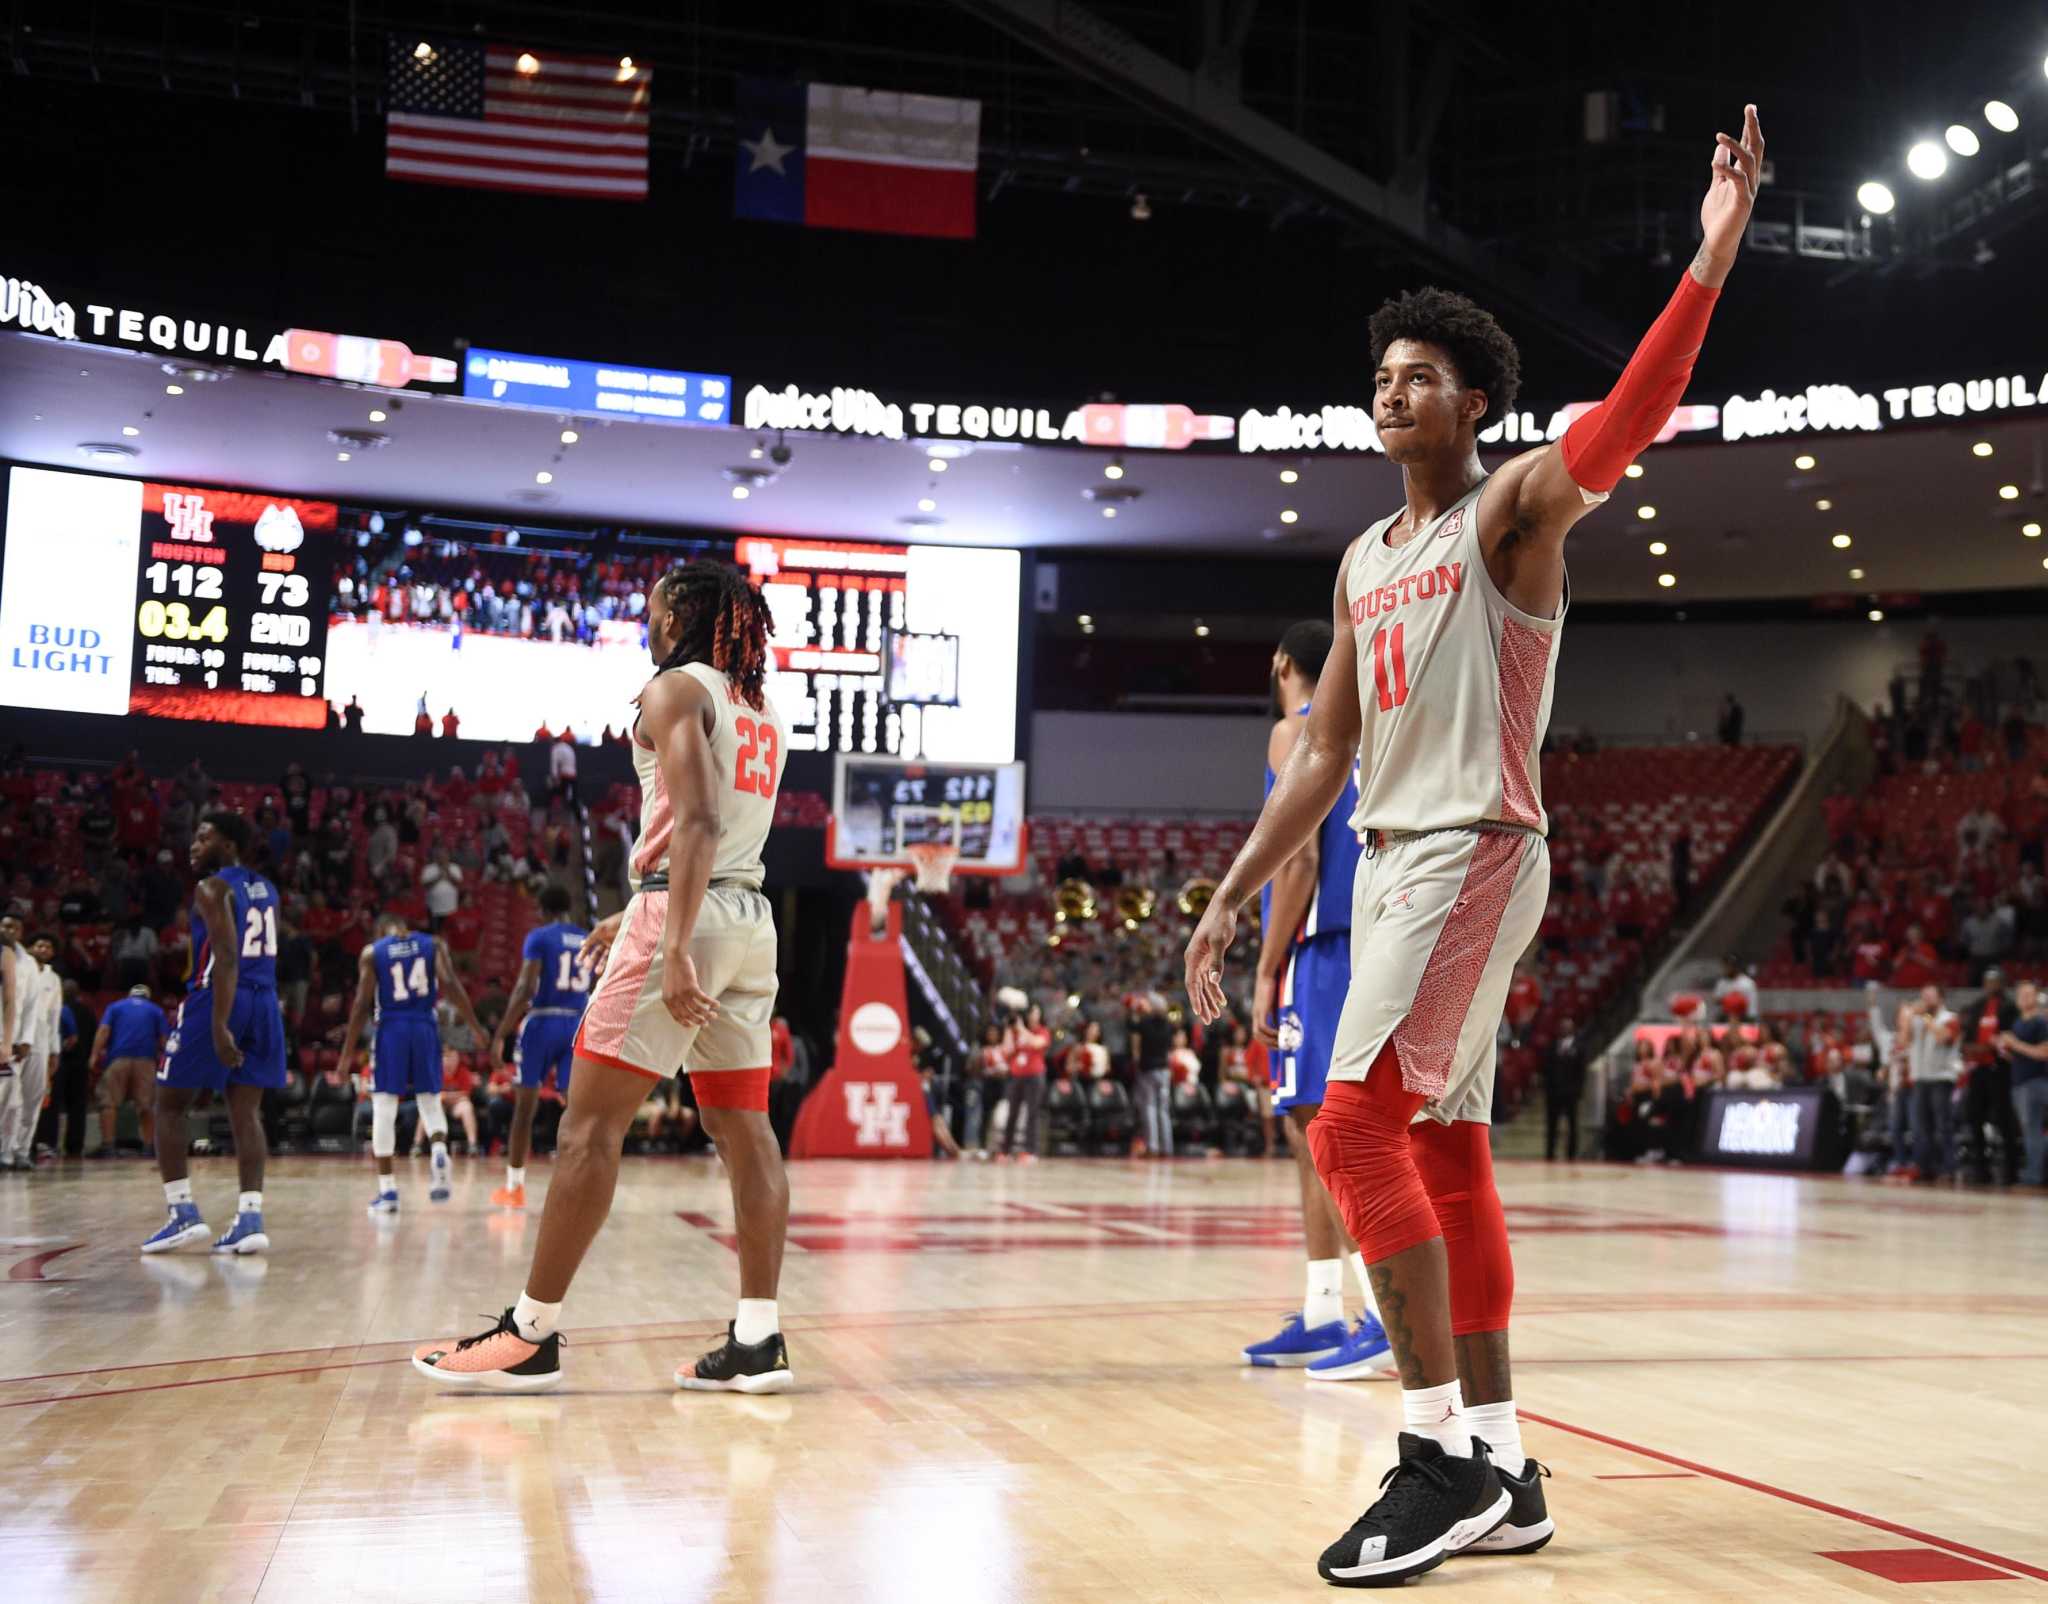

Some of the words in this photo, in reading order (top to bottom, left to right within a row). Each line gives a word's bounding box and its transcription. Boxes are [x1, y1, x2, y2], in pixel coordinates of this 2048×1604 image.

[87, 304, 286, 364] TEQUILA
[910, 403, 1087, 439] TEQUILA
[152, 542, 227, 565] HOUSTON
[145, 561, 224, 599] 112
[257, 572, 309, 607] 73
[29, 624, 101, 649] BUD
[139, 600, 229, 643] 03.4
[250, 612, 311, 646] 2ND
[12, 647, 115, 674] LIGHT
[1373, 622, 1410, 713] 11
[735, 715, 778, 800] 23
[241, 905, 278, 958] 21
[390, 957, 430, 1001] 14
[843, 1081, 912, 1147] UH
